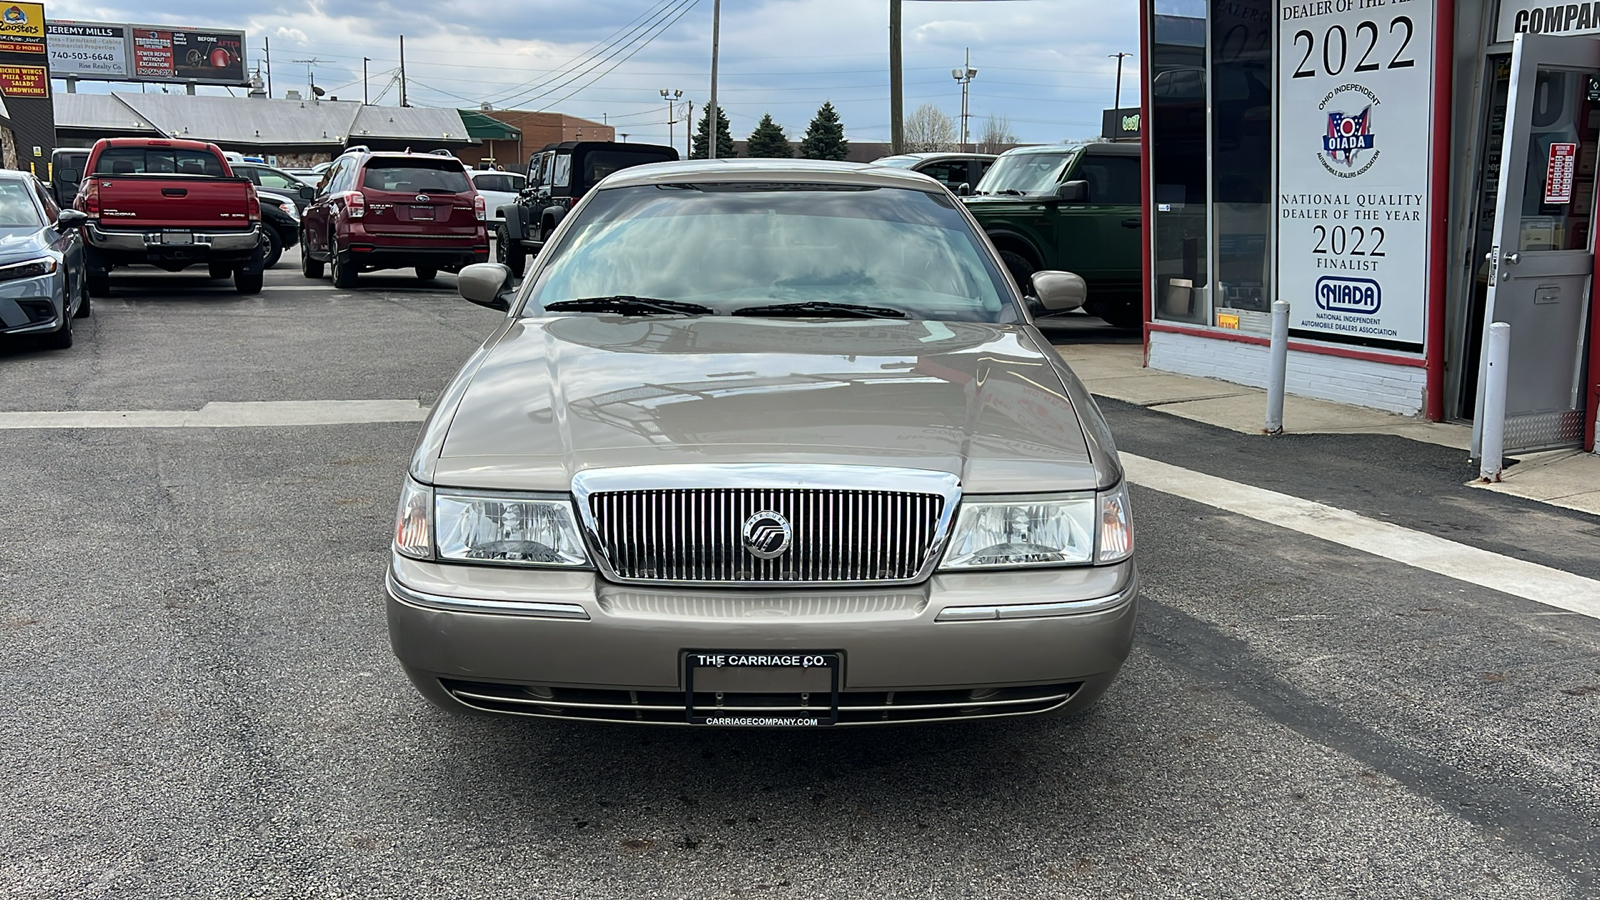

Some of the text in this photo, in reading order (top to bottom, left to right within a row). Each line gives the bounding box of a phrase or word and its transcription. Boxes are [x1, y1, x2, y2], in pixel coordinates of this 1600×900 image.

[1283, 1, 1332, 20] DEALER
[1336, 0, 1352, 12] OF
[48, 26, 113, 36] JEREMY MILLS
[1292, 15, 1415, 79] 2022
[51, 51, 114, 61] 740-503-6648
[92, 63, 111, 71] Realty
[1318, 83, 1381, 111] OHIO INDEPENDENT
[1329, 136, 1365, 149] OIADA
[1317, 152, 1338, 177] AUTOMOBILE
[1357, 150, 1380, 175] ASSOCIATION
[1281, 194, 1423, 207] NATIONAL QUALITY
[1282, 209, 1420, 221] DEALER OF THE YEAR
[1312, 225, 1386, 257] 2022
[1317, 258, 1379, 272] FINALIST
[1320, 284, 1375, 306] NIADA
[1316, 313, 1381, 325] NATIONAL INDEPENDENT
[1301, 320, 1398, 337] AUTOMOBILE DEALERS ASSOCIATION
[697, 655, 827, 667] THE CARRIAGE CO.
[706, 717, 818, 726] CARRIAGECOMPANY.COM
